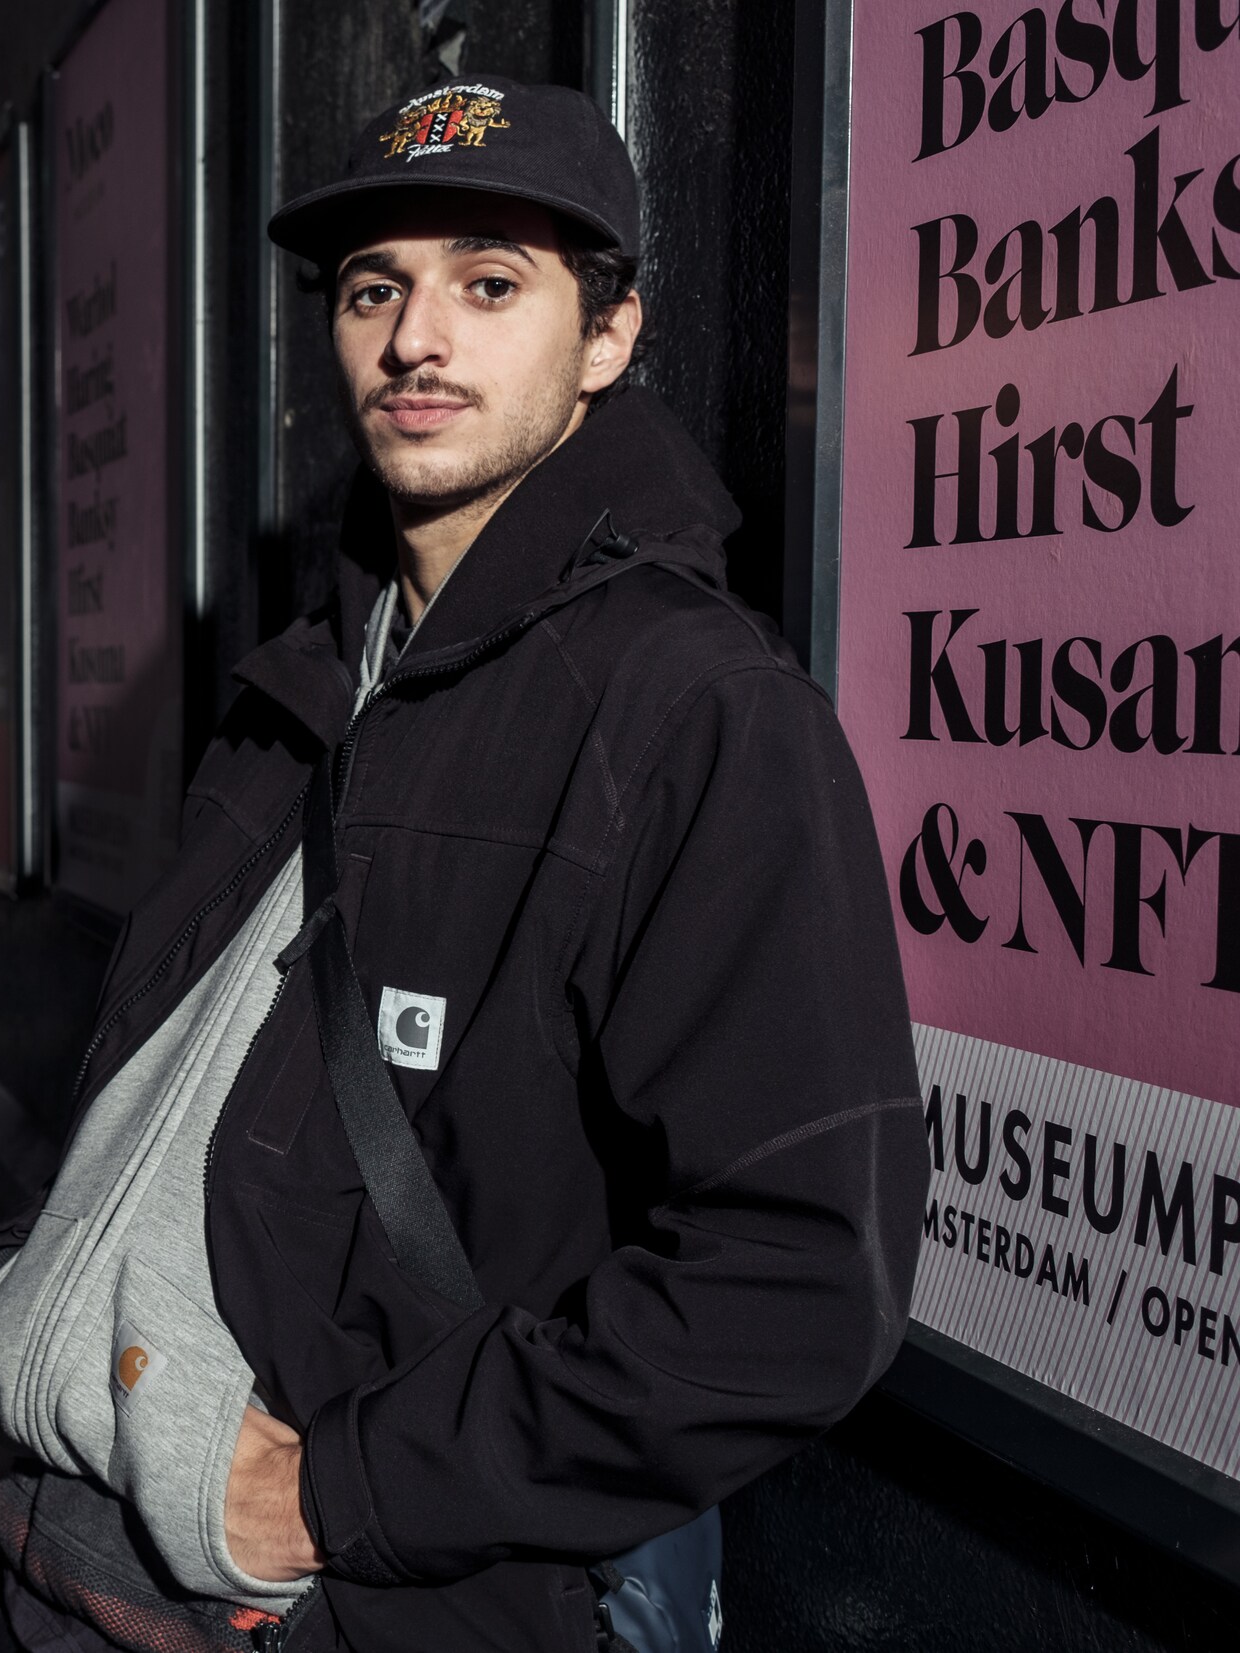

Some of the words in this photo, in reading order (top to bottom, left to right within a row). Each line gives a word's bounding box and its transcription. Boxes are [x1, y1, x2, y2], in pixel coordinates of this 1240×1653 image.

[903, 362, 1195, 549] Hirst
[899, 803, 990, 943] &
[383, 1044, 426, 1059] carhartt
